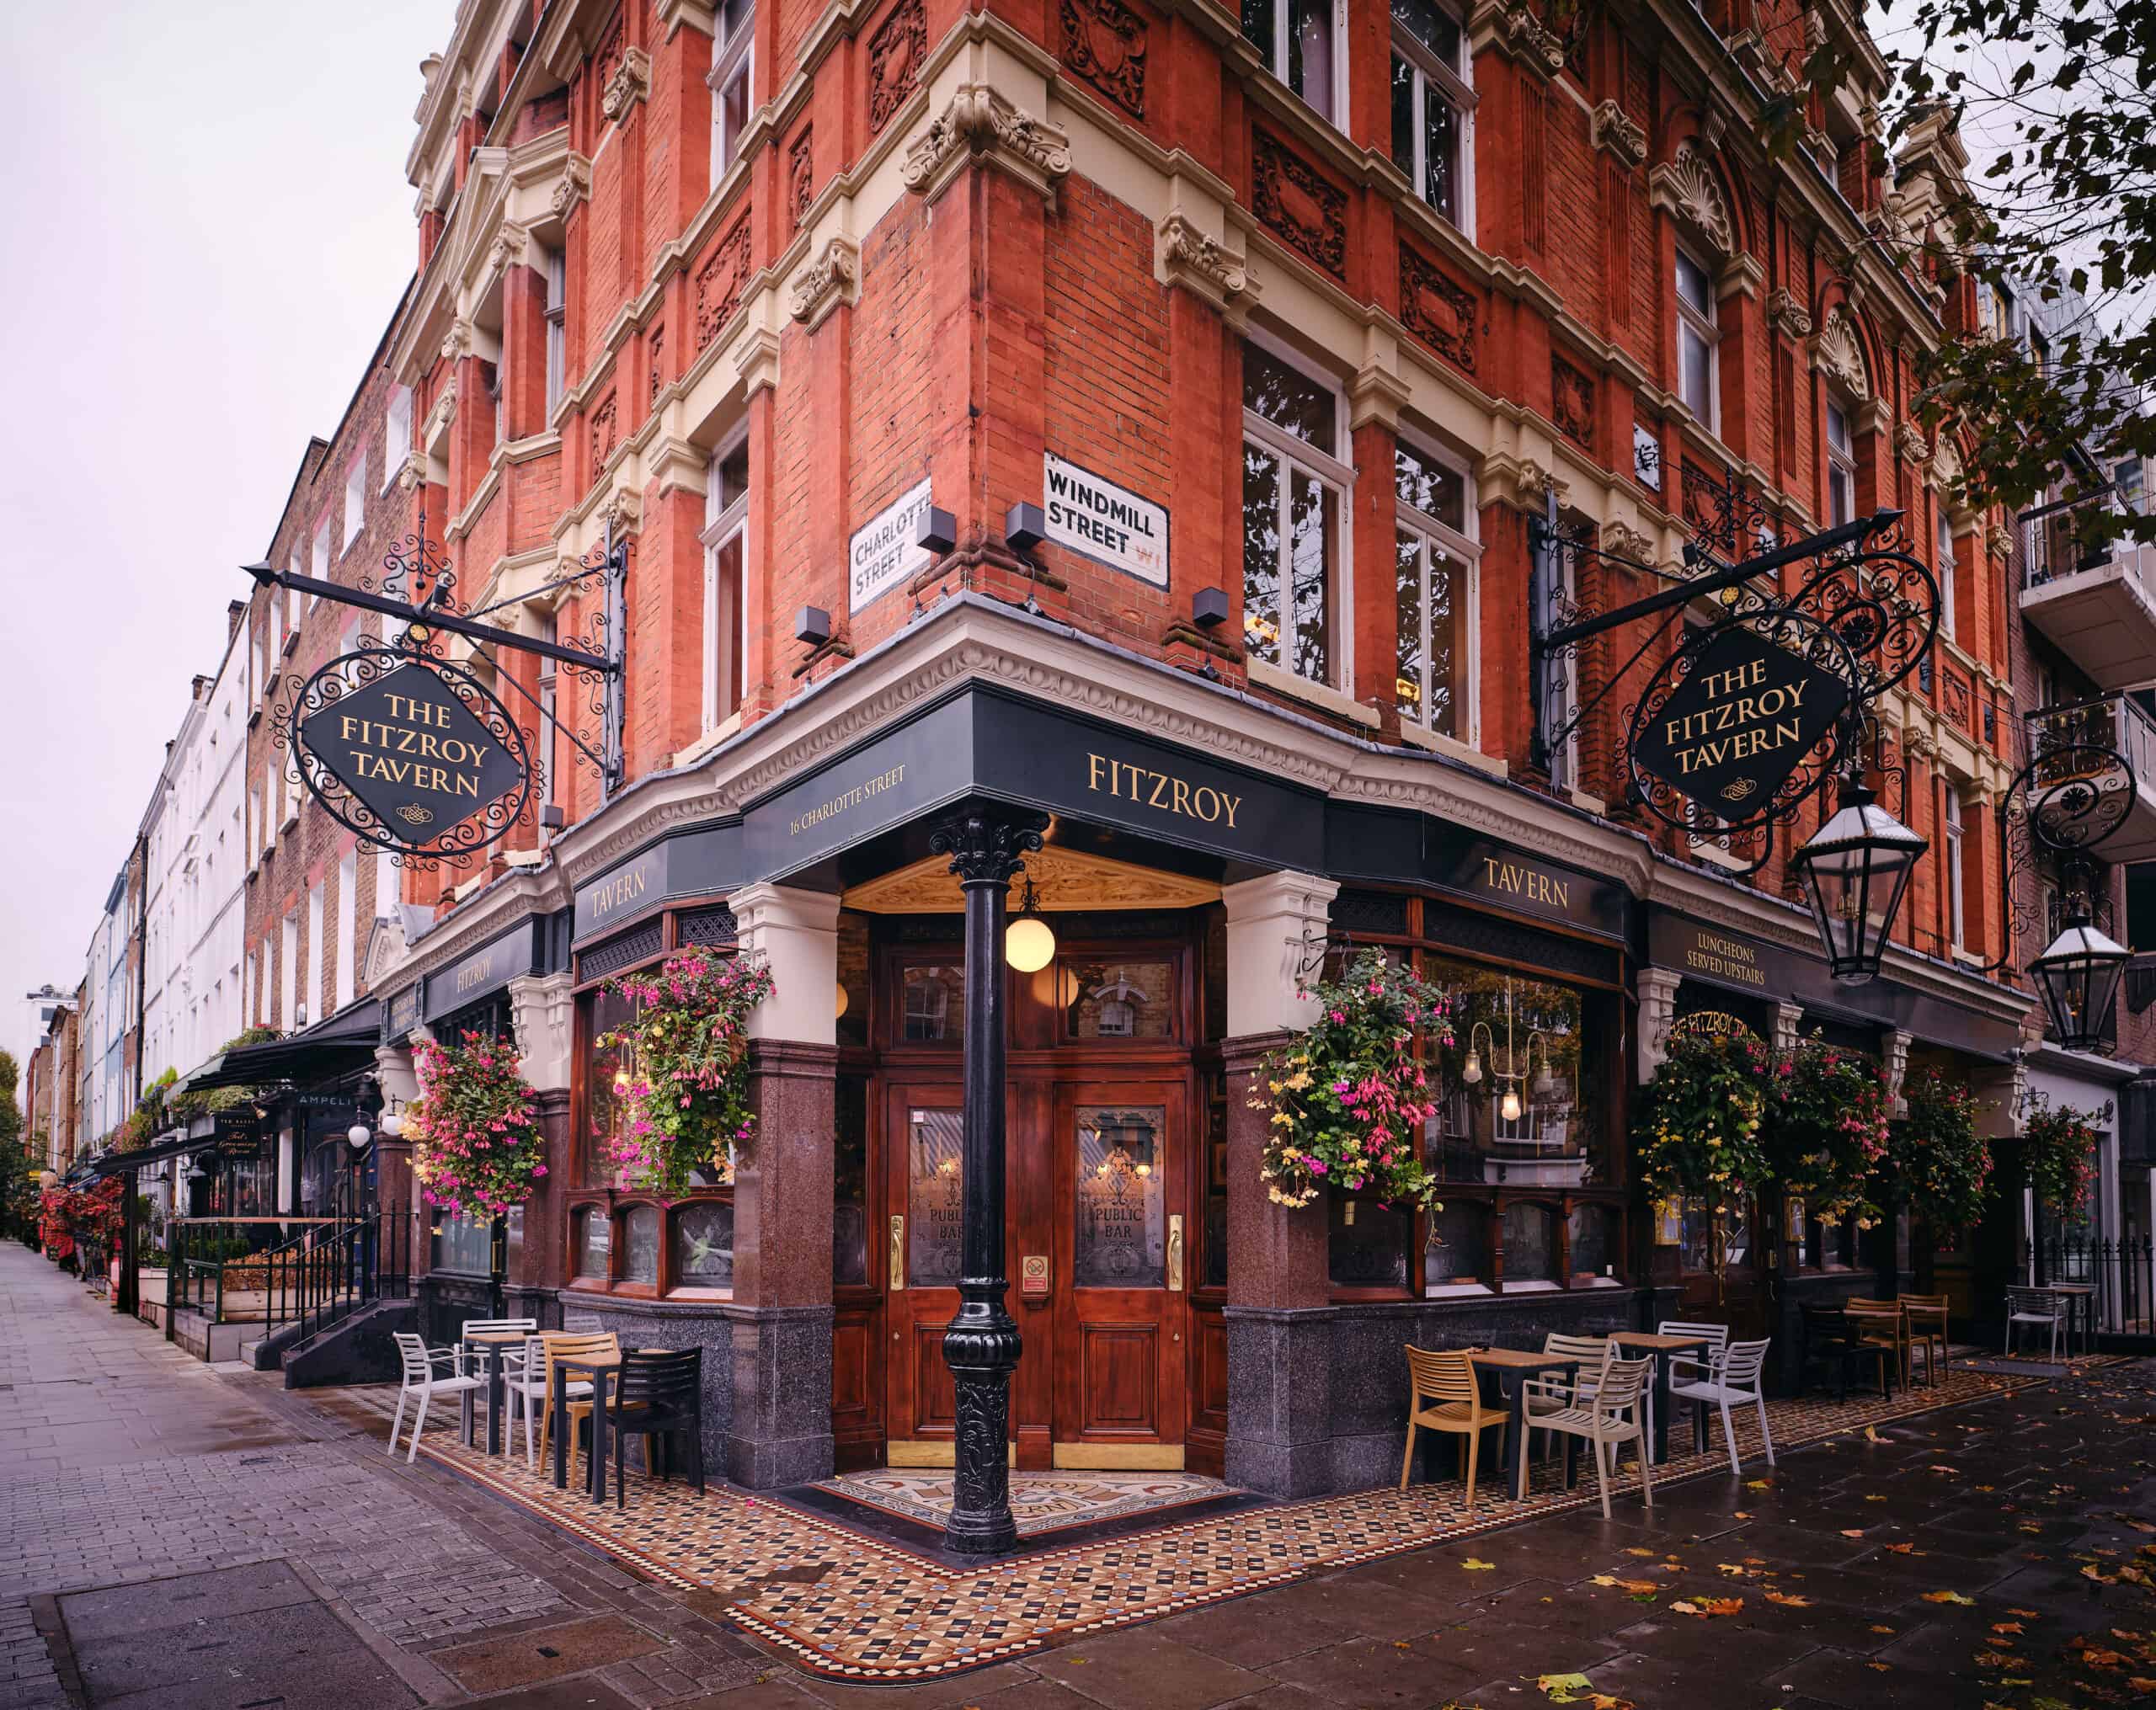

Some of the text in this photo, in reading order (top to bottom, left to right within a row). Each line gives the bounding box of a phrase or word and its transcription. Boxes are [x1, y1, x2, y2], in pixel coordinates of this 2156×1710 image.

[1048, 469, 1154, 538] WINDMILL
[1049, 501, 1129, 554] STREET
[856, 542, 905, 595] STREET
[1700, 658, 1767, 699] THE
[384, 693, 451, 728] THE
[1665, 679, 1809, 745] FITZROY
[339, 716, 489, 768] FITZROY
[1674, 717, 1801, 774] TAVERN
[350, 751, 480, 798] TAVERN
[1086, 753, 1242, 828] FITZROY
[789, 764, 905, 835] 16 CHARLOTTE STREET
[593, 866, 646, 918] TAVERN
[1483, 857, 1568, 909] TAVERN
[1687, 951, 1764, 985] SERVED UPSTAIRS
[1698, 932, 1754, 964] LUNCHEONS
[457, 956, 492, 993] FITZROY
[299, 1096, 351, 1105] AMPELI
[930, 1208, 962, 1222] PUBL
[1096, 1208, 1142, 1221] PUBLIC
[1105, 1225, 1132, 1238] BAR
